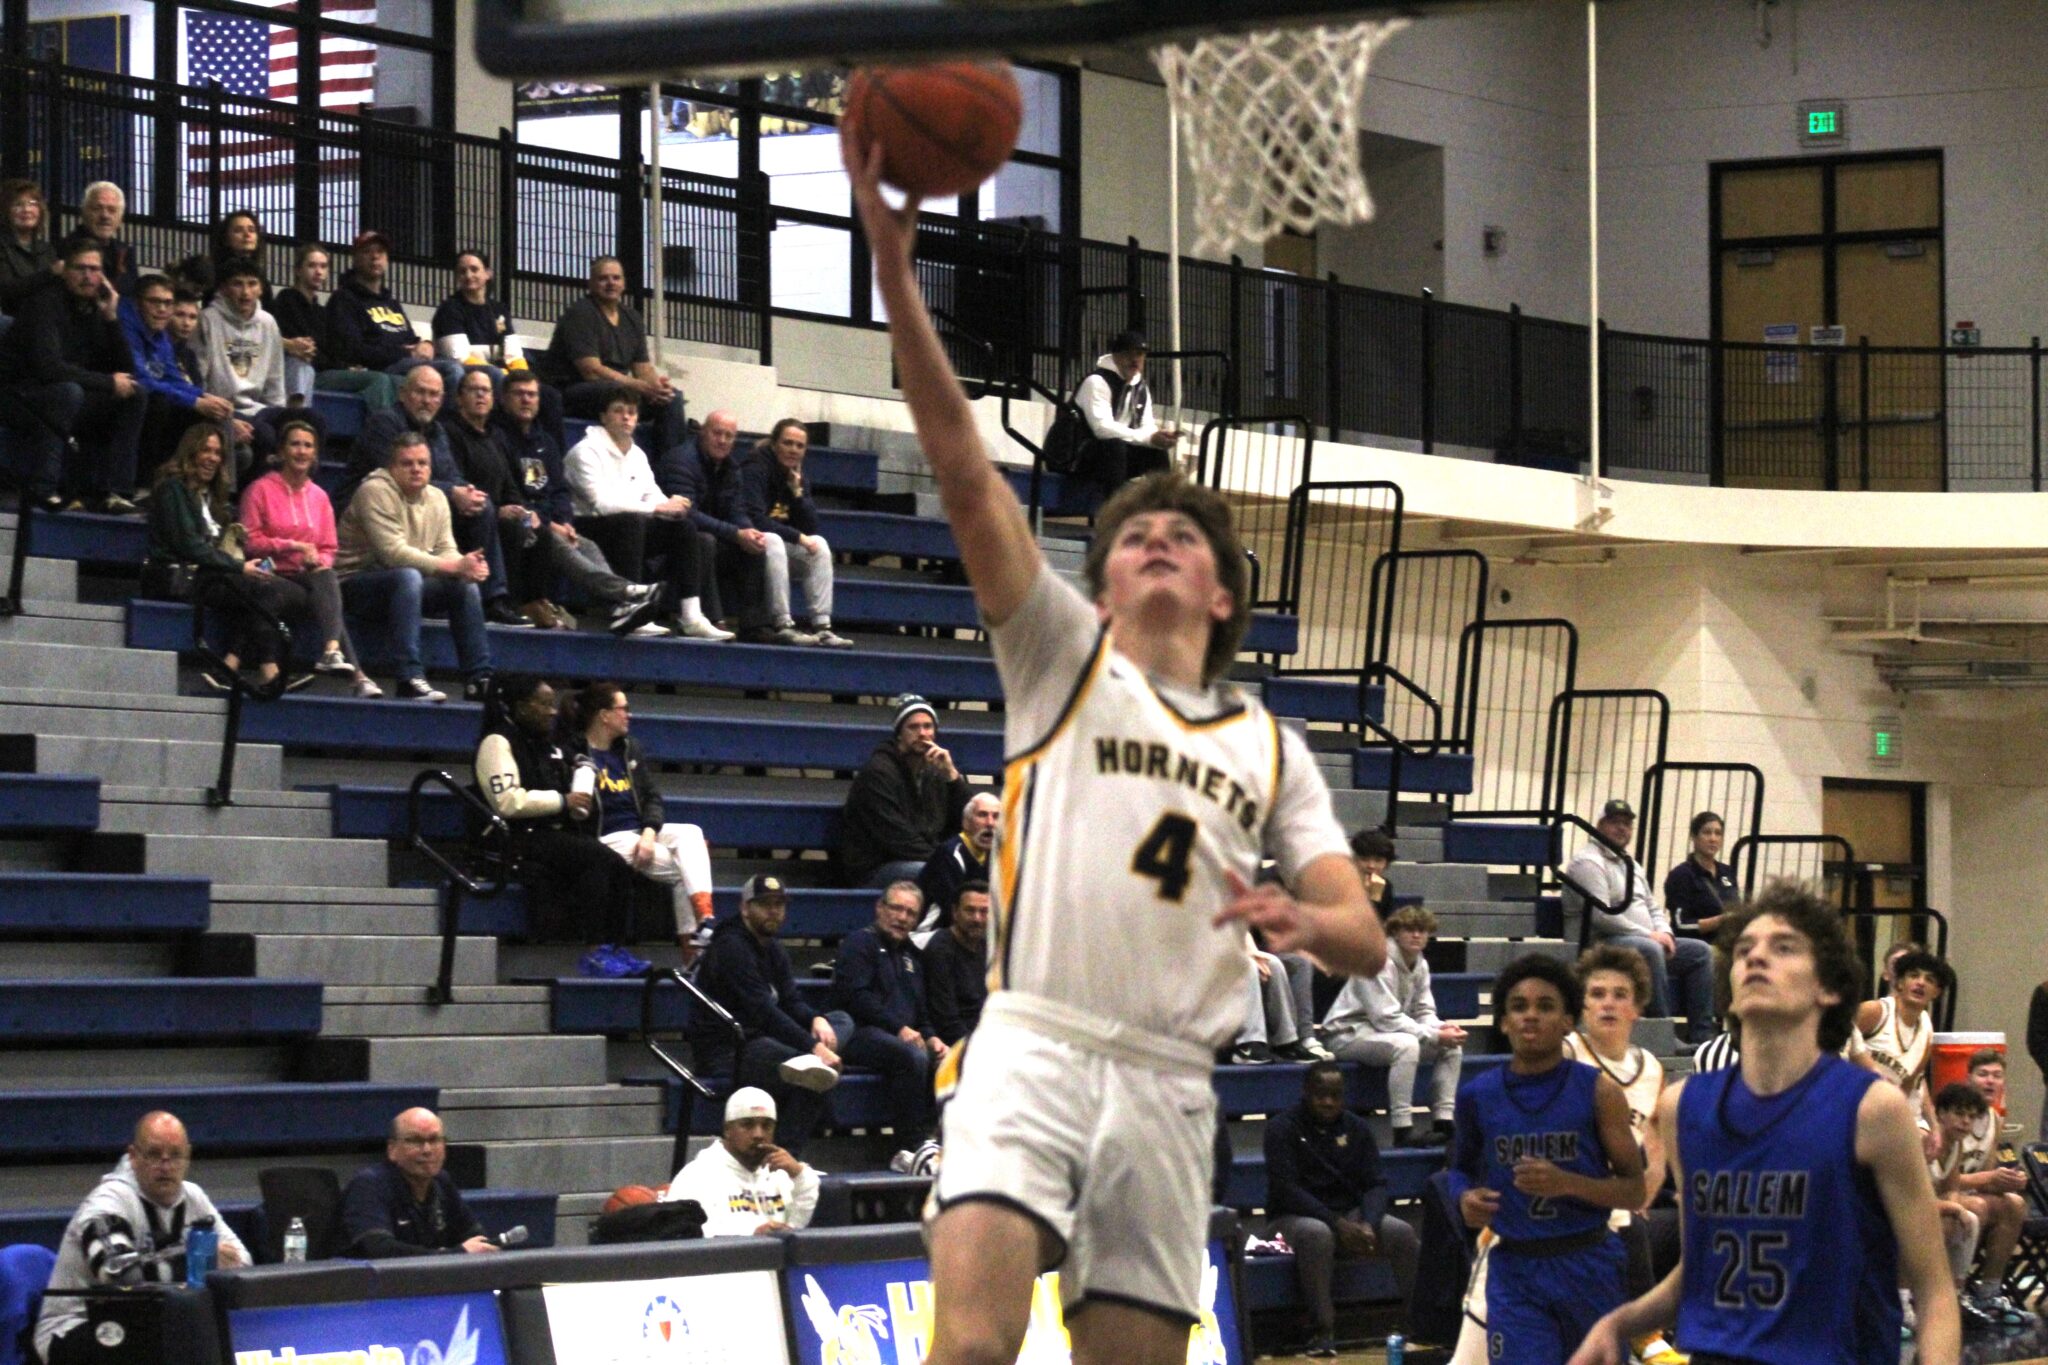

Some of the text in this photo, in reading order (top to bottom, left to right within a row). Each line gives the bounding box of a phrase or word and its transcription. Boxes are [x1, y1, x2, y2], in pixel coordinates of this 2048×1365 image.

[1129, 807, 1198, 907] 4
[1494, 1131, 1579, 1163] SALEM
[1692, 1169, 1809, 1219] SALEM
[1713, 1230, 1788, 1310] 25
